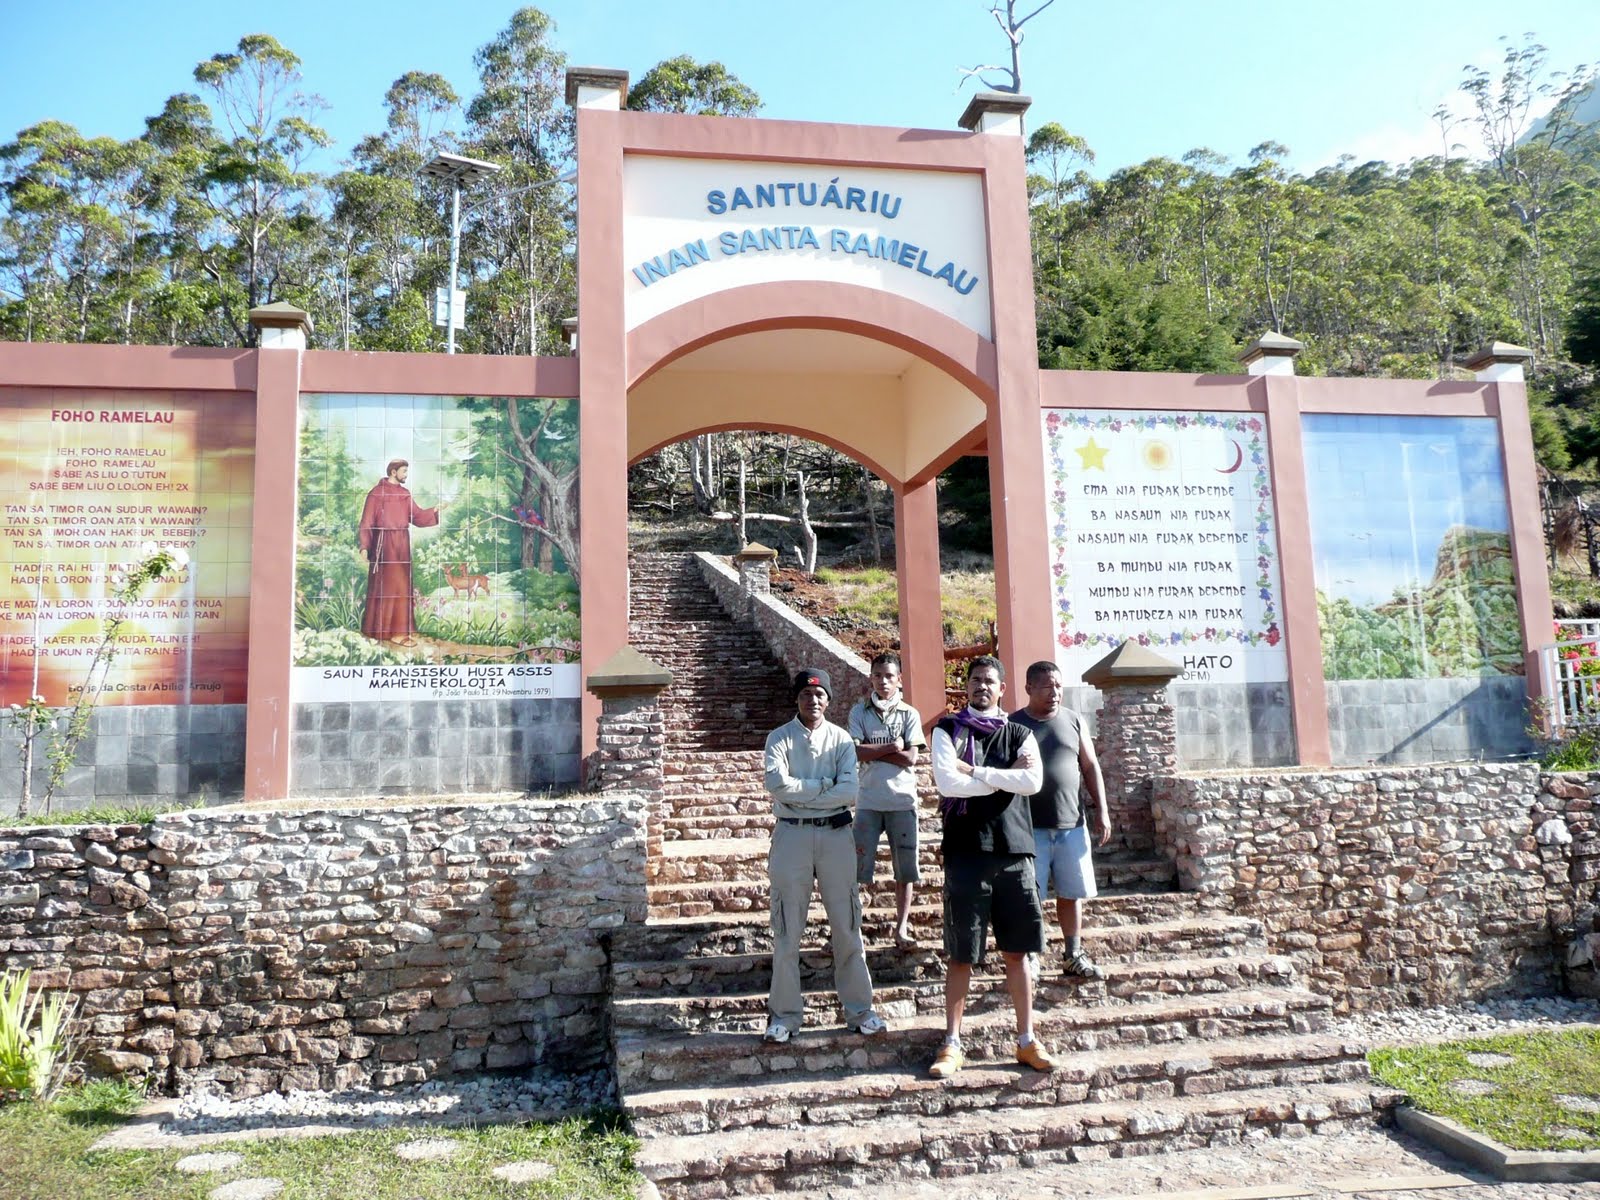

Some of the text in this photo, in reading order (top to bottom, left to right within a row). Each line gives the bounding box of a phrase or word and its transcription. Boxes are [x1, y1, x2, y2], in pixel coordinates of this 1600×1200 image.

[707, 176, 902, 220] SANTUÁRIU
[632, 225, 979, 296] INAN SANTA RAMELAU
[51, 410, 175, 424] FOHO RAMELAU
[81, 448, 111, 456] FOHO
[115, 448, 166, 457] RAMELAU
[66, 459, 156, 468] FOHO RAMELAU
[54, 470, 167, 479] SABE AS LIU O TUTUN
[29, 482, 189, 491] SABE BEM LIU O LOLON EH! 2X
[1083, 485, 1108, 496] EMA
[1116, 485, 1136, 496] NIA
[1142, 485, 1180, 497] FURAK
[5, 505, 208, 514] TAN SA TIMOR OAN SUDUR WAWAIN?
[1091, 510, 1232, 522] BA NASAUN NIA FURAK
[7, 517, 201, 525] TAN SA TIMOR OAN ATAN WAWAIN?
[4, 529, 24, 537] TAN
[28, 529, 42, 537] SA
[46, 529, 80, 537] IMOR
[83, 529, 106, 537] OAN
[1077, 533, 1126, 544] NASAUN
[1129, 533, 1149, 544] NIA
[1156, 533, 1194, 544] FURAK
[13, 541, 33, 549] TAN
[37, 541, 52, 549] SA
[56, 541, 90, 549] TIMOR
[94, 541, 116, 549] OAN
[81, 564, 101, 572] HU
[1097, 561, 1233, 574] BA MUNDU NIA FURAK
[54, 576, 92, 584] LORON
[1088, 586, 1130, 598] MUNDU
[1134, 586, 1154, 598] NIA
[1158, 586, 1194, 598] FURAK
[56, 600, 93, 608] LORON
[158, 600, 177, 608] IHA
[57, 612, 95, 620] LORON
[131, 612, 149, 620] IHA
[153, 612, 168, 620] ITA
[172, 612, 190, 620] NIA
[194, 612, 219, 620] RAIN
[1095, 609, 1243, 621] BA NATUREZA NIA FURAK
[44, 636, 75, 644] KA'ER
[118, 635, 147, 644] KUDA
[150, 635, 179, 644] TALIN
[53, 648, 82, 656] UKUN
[124, 648, 140, 656] ITA
[144, 648, 170, 656] RAIN
[1183, 655, 1233, 669] HATO
[323, 667, 553, 679] SAUN FRANSISKU HUSI ASSIS
[116, 682, 146, 692] Costa
[369, 678, 506, 689] MAHEIN EKOLOJIA
